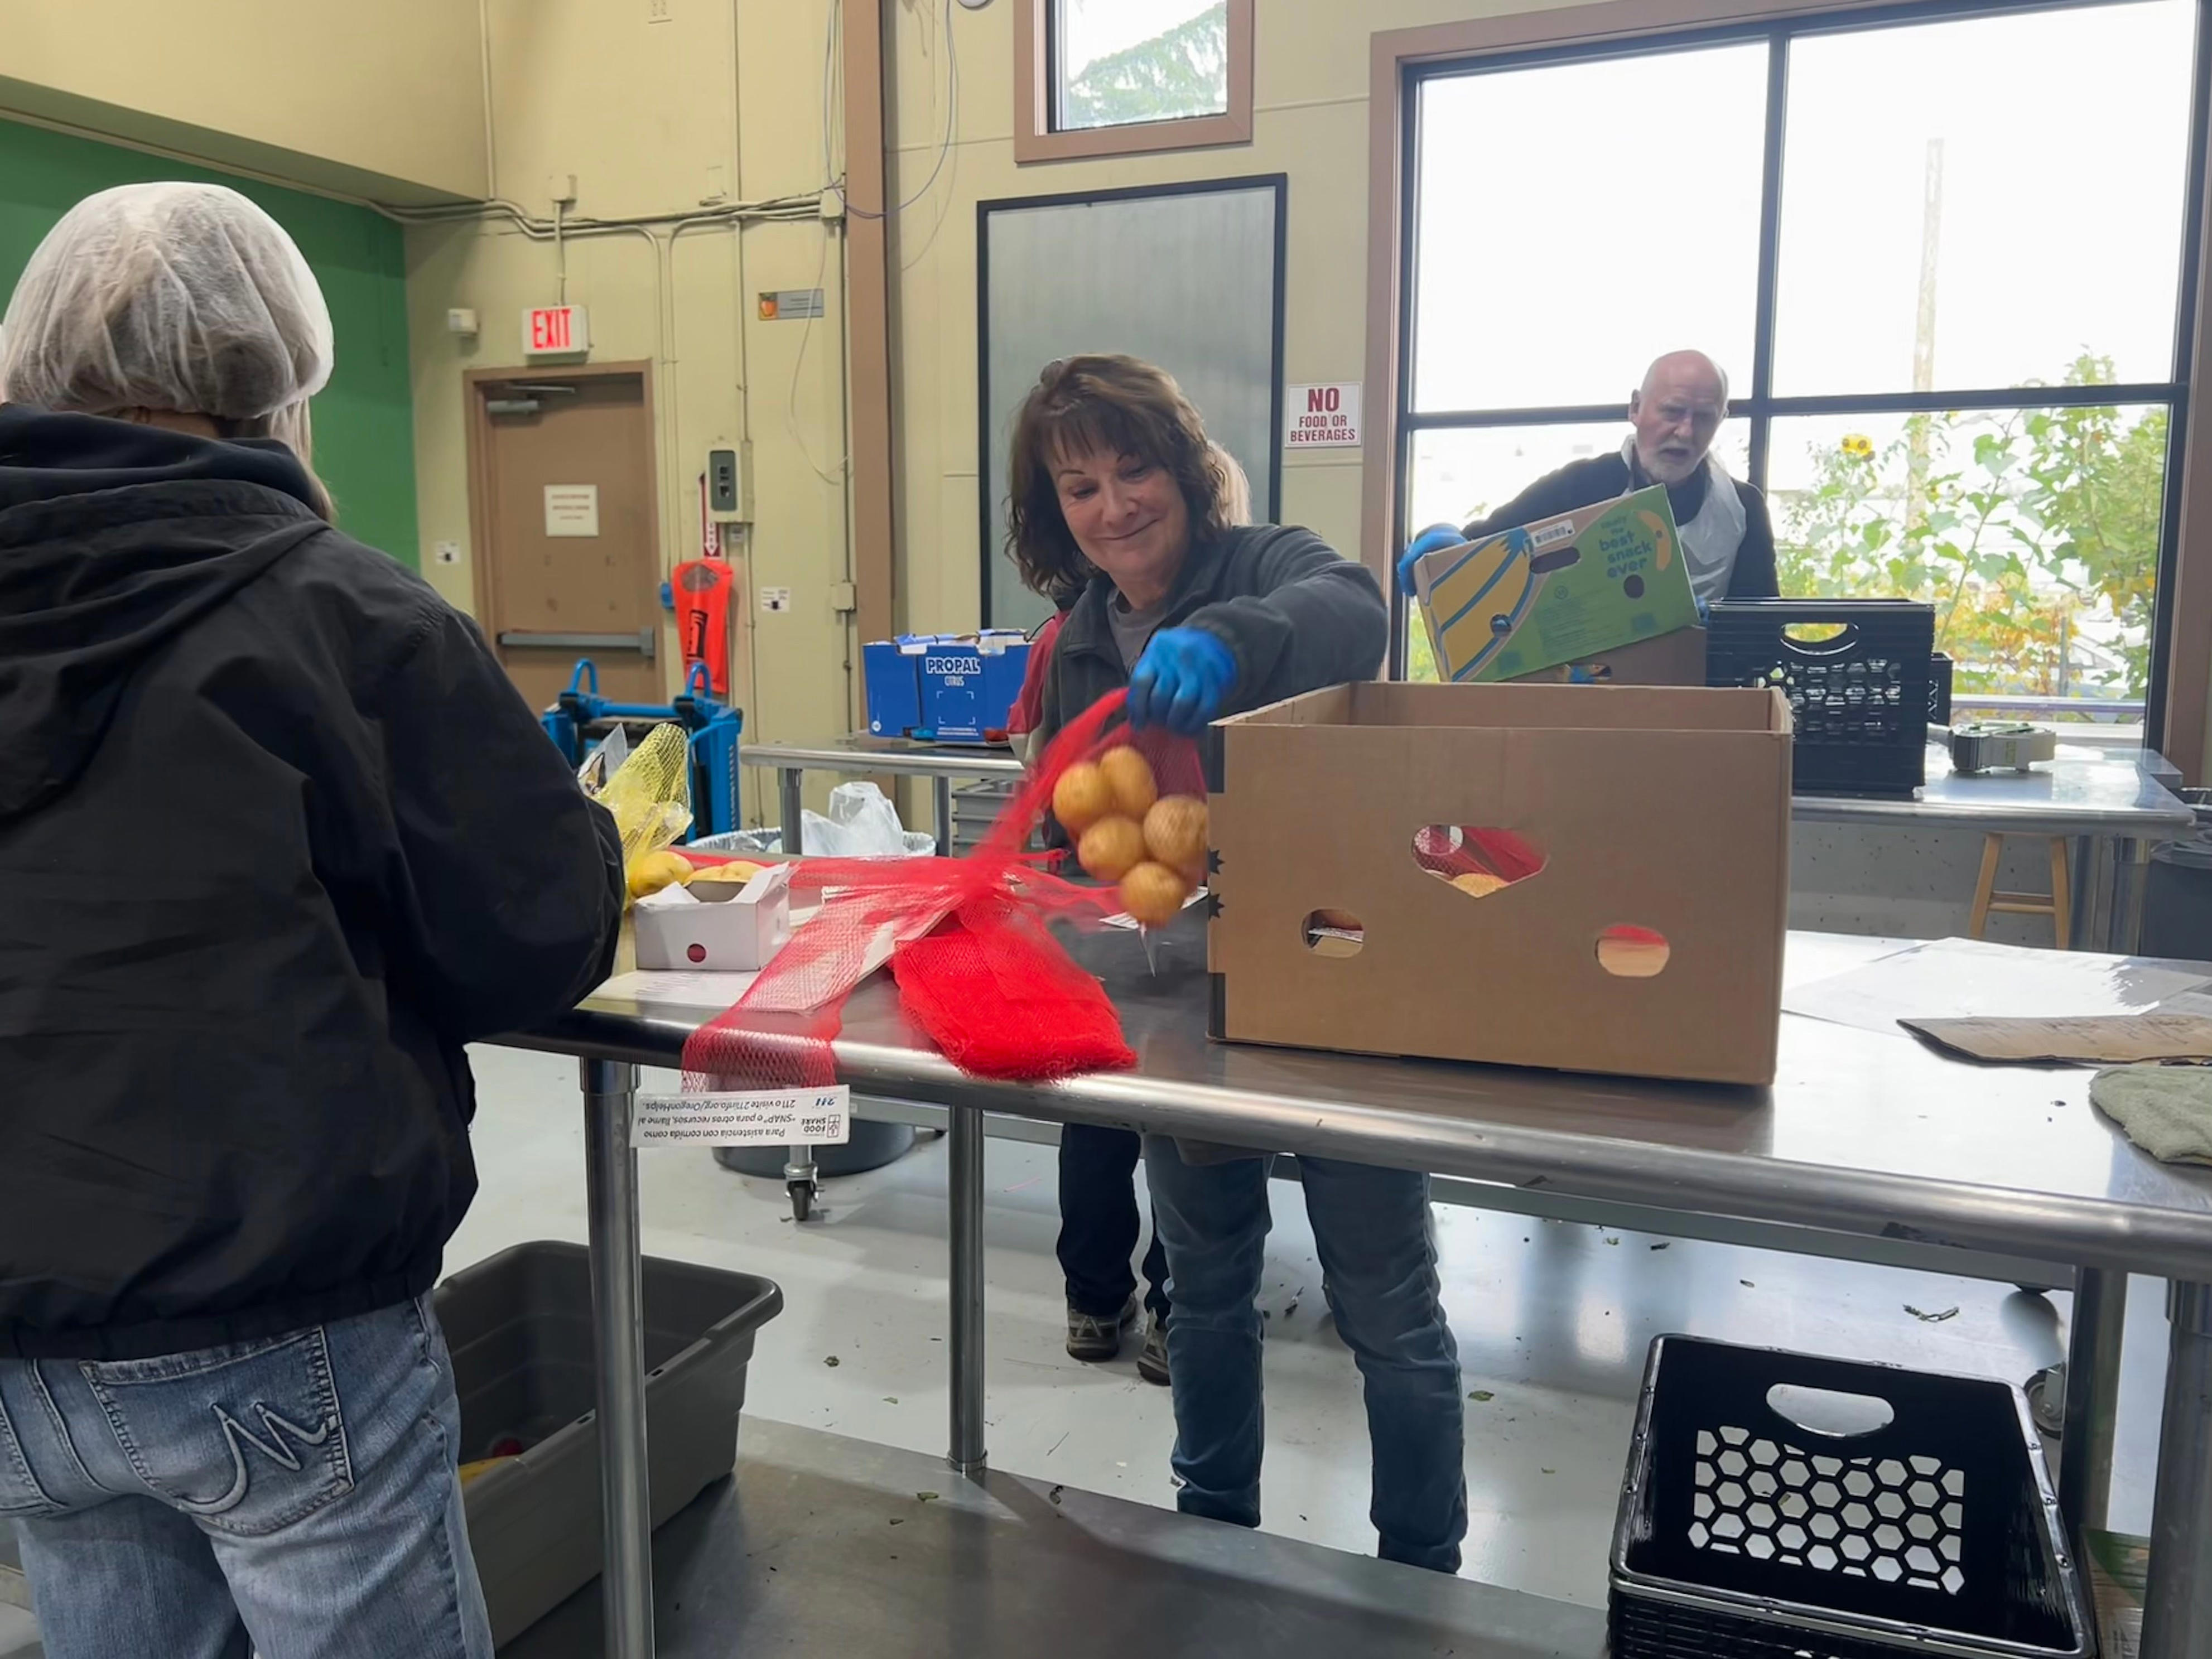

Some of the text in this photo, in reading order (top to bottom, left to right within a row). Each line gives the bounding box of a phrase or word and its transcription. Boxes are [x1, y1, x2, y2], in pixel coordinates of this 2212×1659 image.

[533, 308, 570, 348] EXIT
[1308, 388, 1339, 412] NO
[1299, 414, 1347, 428] FOOD OR
[1290, 428, 1356, 442] BEVERAGES
[1599, 530, 1635, 552] best
[1607, 558, 1647, 578] ever
[926, 657, 981, 674] PROPAL
[750, 1100, 774, 1110] visite
[736, 1113, 756, 1122] para
[670, 1129, 701, 1140] comida
[721, 1128, 764, 1138] asistencia
[765, 1129, 785, 1137] Para
